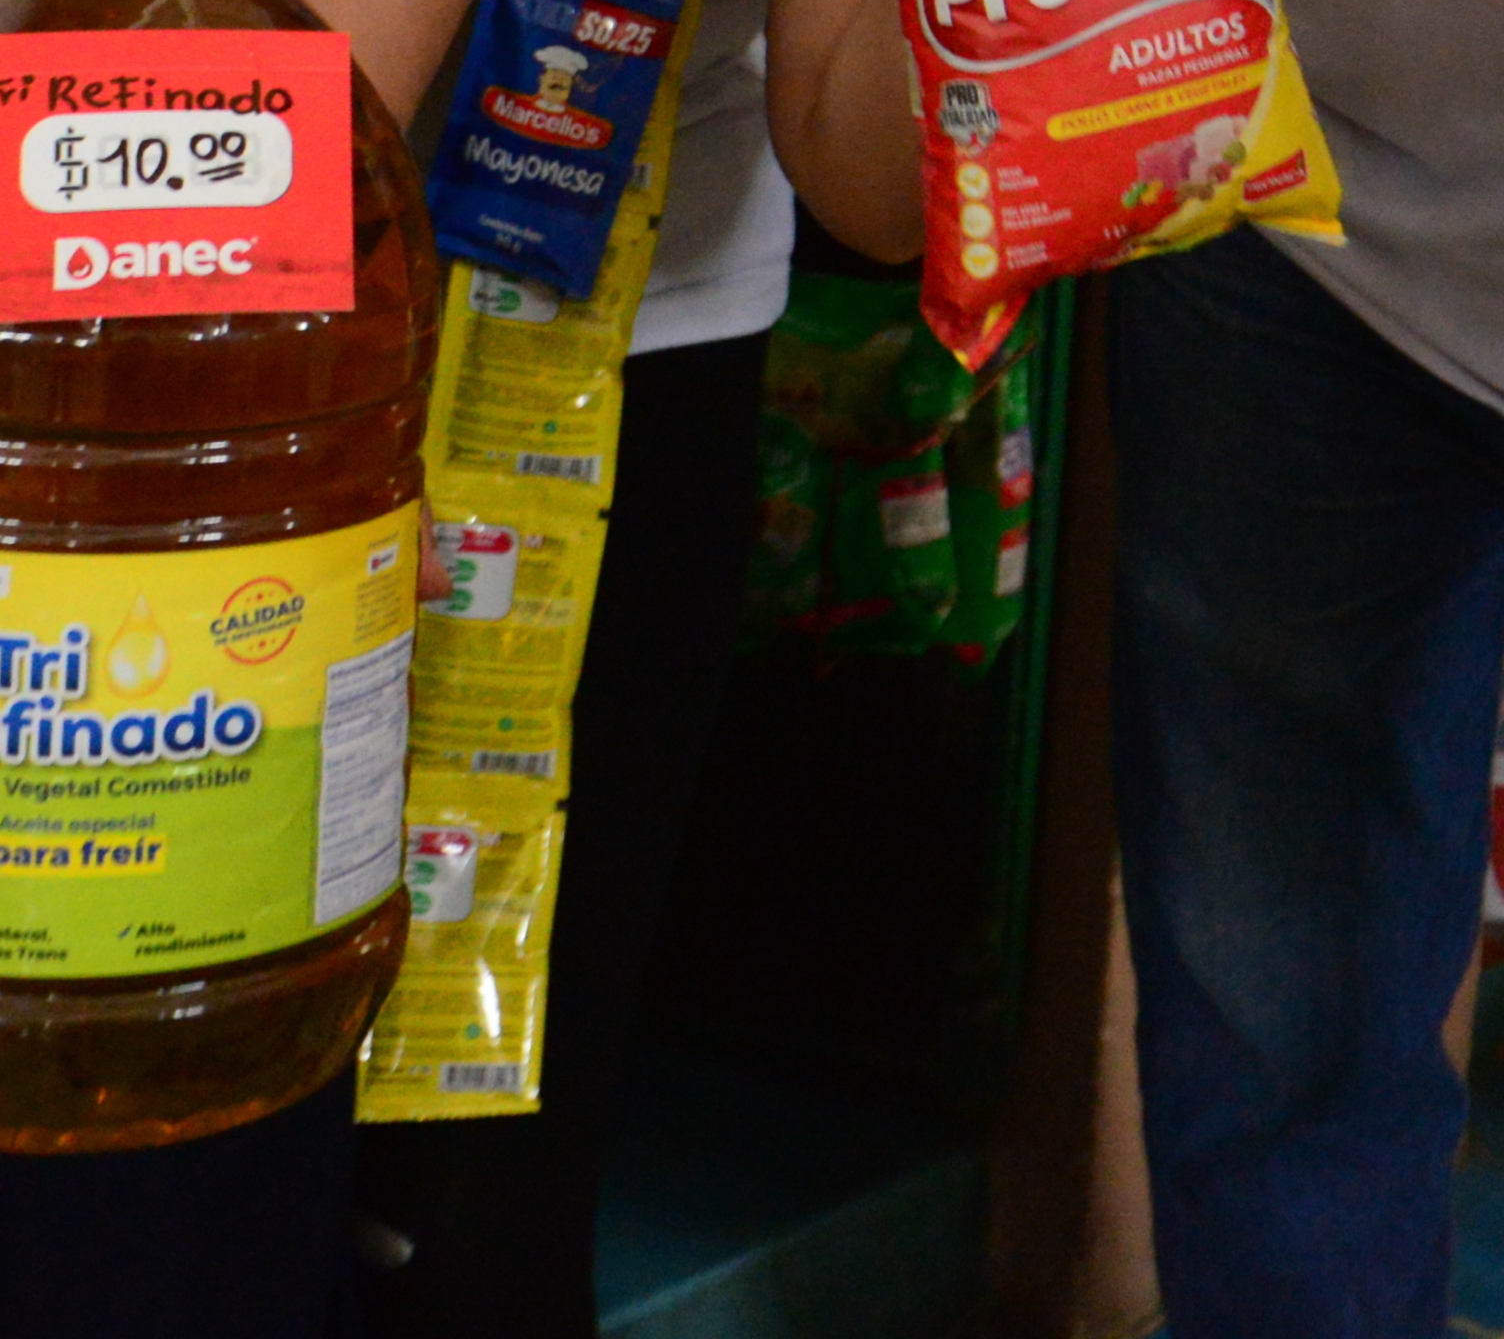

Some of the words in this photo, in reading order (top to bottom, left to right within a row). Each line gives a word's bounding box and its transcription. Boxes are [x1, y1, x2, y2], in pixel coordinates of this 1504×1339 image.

[1108, 10, 1247, 74] ADULTOS
[1136, 59, 1182, 88] RAZAS
[945, 83, 980, 107] PRO
[491, 93, 602, 145] Marcello's
[464, 133, 606, 197] Mayonesa
[52, 236, 256, 292] Danec
[209, 594, 306, 637] CALIDAD
[4, 776, 102, 803] Vegetal
[107, 765, 253, 798] Comestible
[67, 811, 157, 835] especial
[80, 836, 163, 866] freír
[135, 922, 176, 937] Alto
[135, 929, 247, 958] rendimiento
